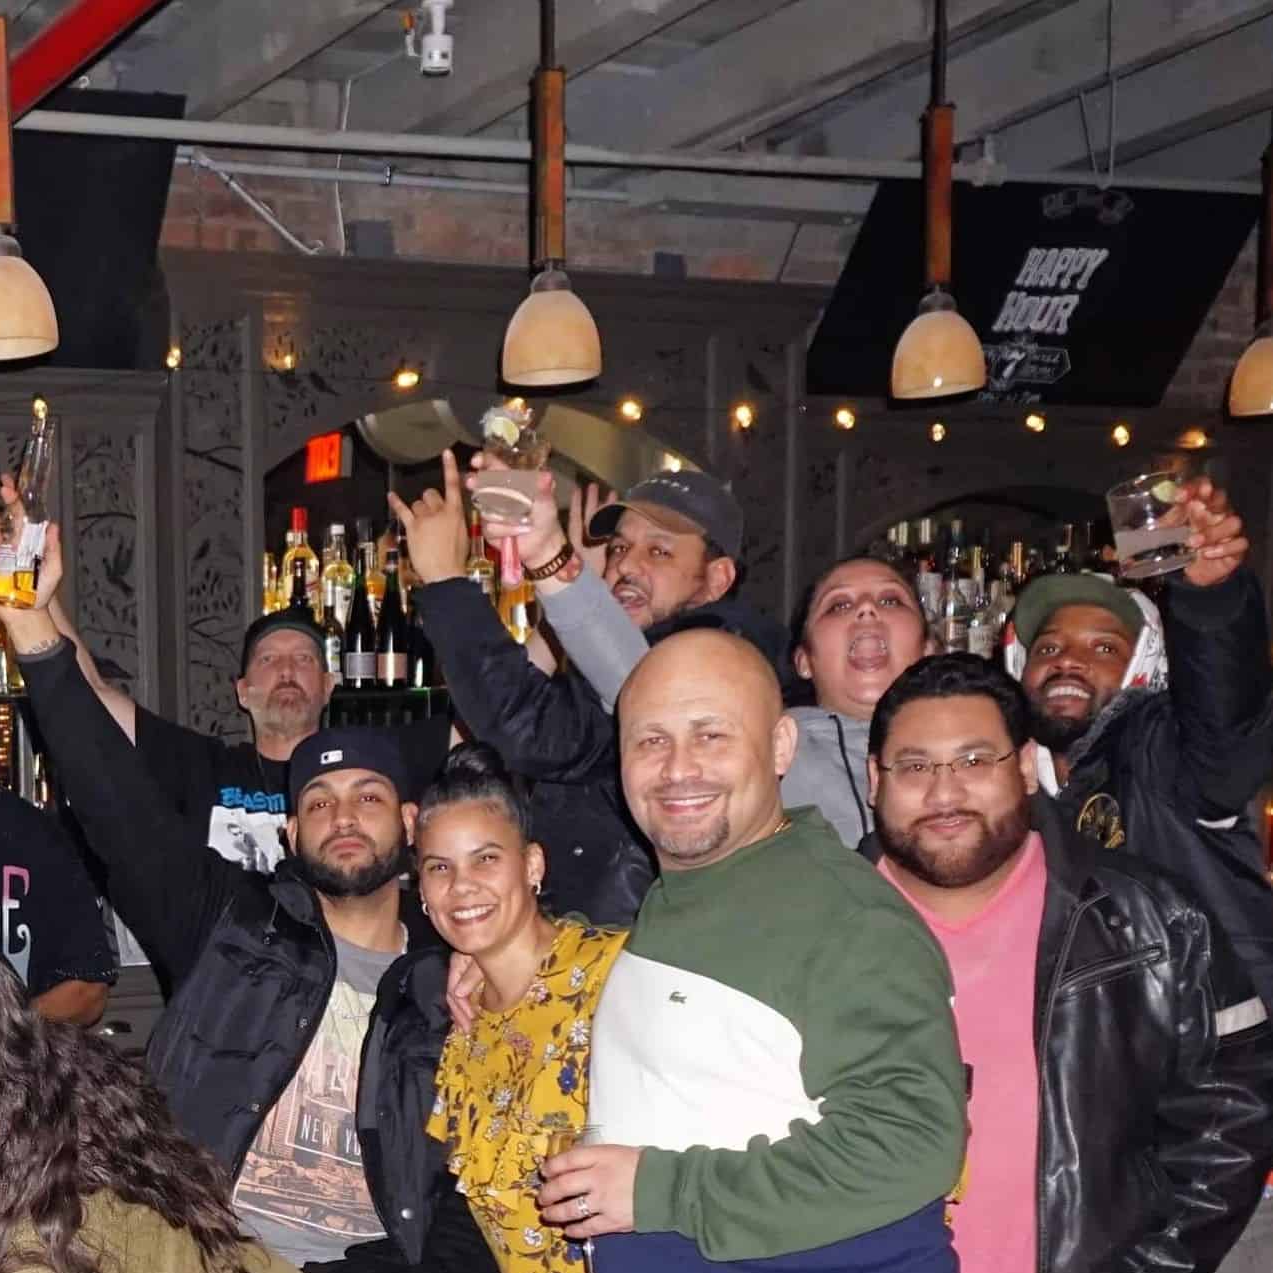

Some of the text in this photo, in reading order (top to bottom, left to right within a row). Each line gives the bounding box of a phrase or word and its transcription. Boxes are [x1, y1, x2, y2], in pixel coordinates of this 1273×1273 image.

[1015, 247, 1109, 289] HAPPY
[991, 290, 1079, 335] HOUR
[300, 1113, 335, 1147] NEW
